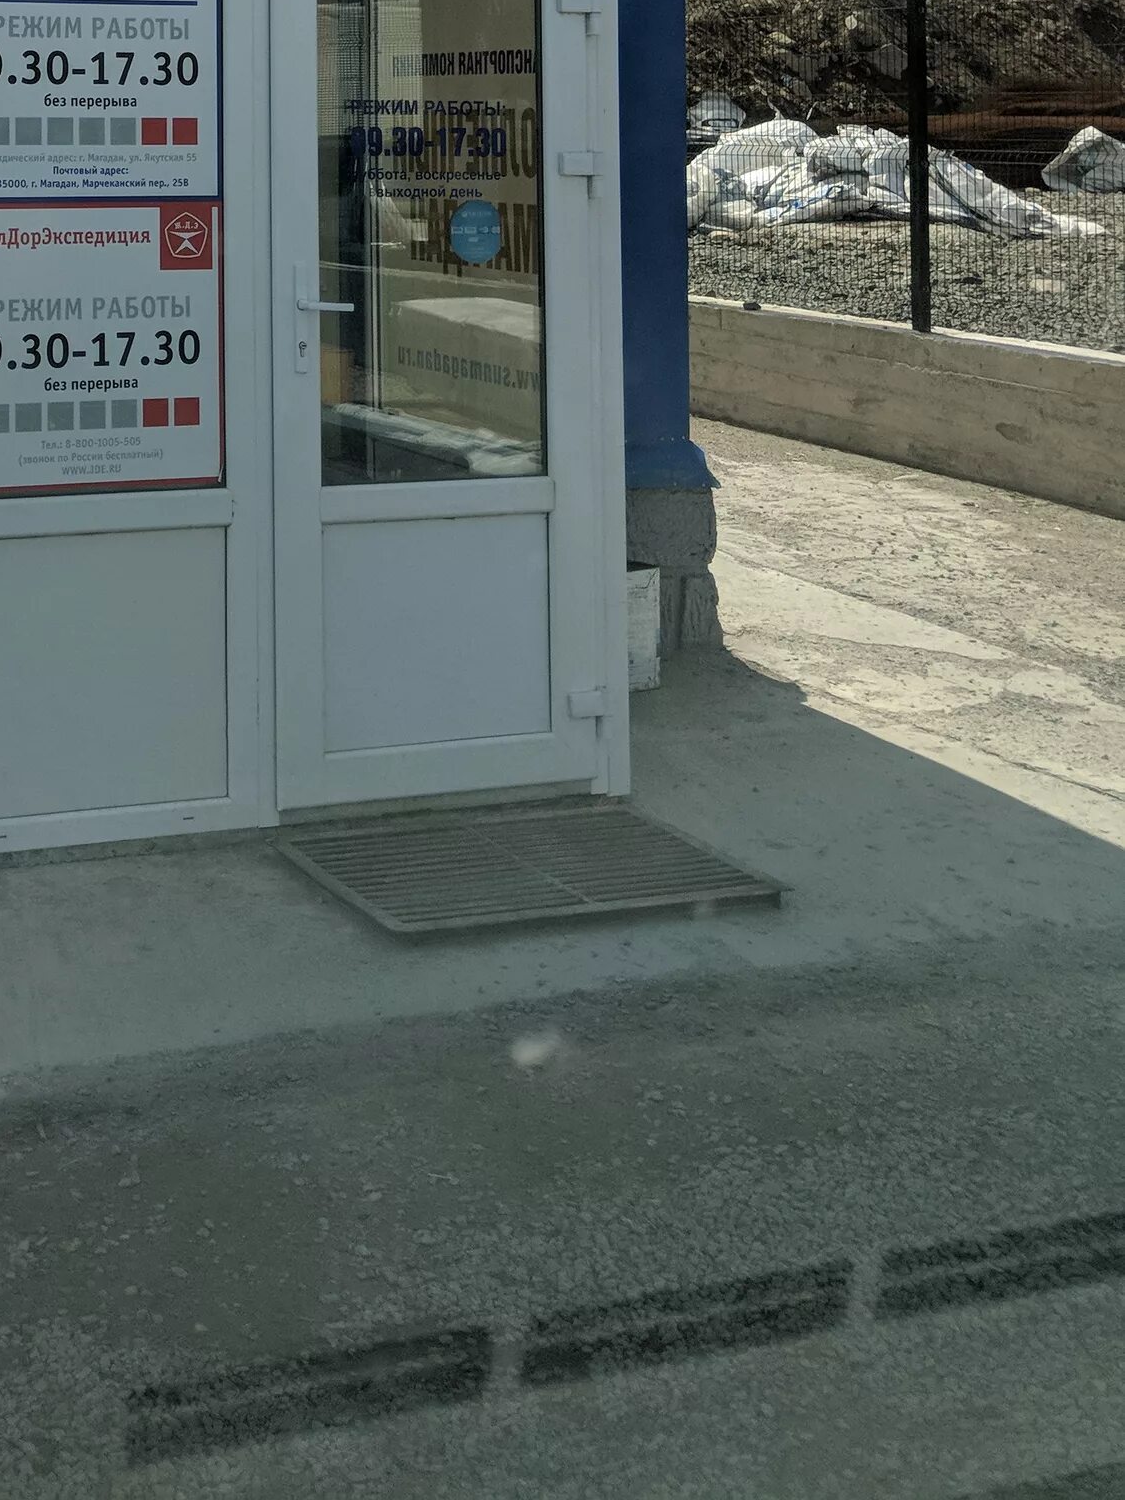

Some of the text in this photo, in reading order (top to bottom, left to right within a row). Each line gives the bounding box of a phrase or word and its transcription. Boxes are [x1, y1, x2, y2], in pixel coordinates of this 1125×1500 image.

[92, 17, 190, 40] РАБОТЫ
[44, 94, 138, 110] без перерыва
[48, 155, 77, 165] адрес:
[144, 153, 184, 164] Якутская
[187, 153, 197, 163] 55
[53, 165, 129, 177] Почтовый адрес:
[40, 179, 80, 189] Магадан,
[82, 178, 147, 190] Марчеканский
[449, 188, 483, 199] день
[92, 296, 191, 320] РАБОТЫ
[44, 378, 138, 393] без перерыва
[58, 455, 69, 464] по
[71, 452, 103, 463] России
